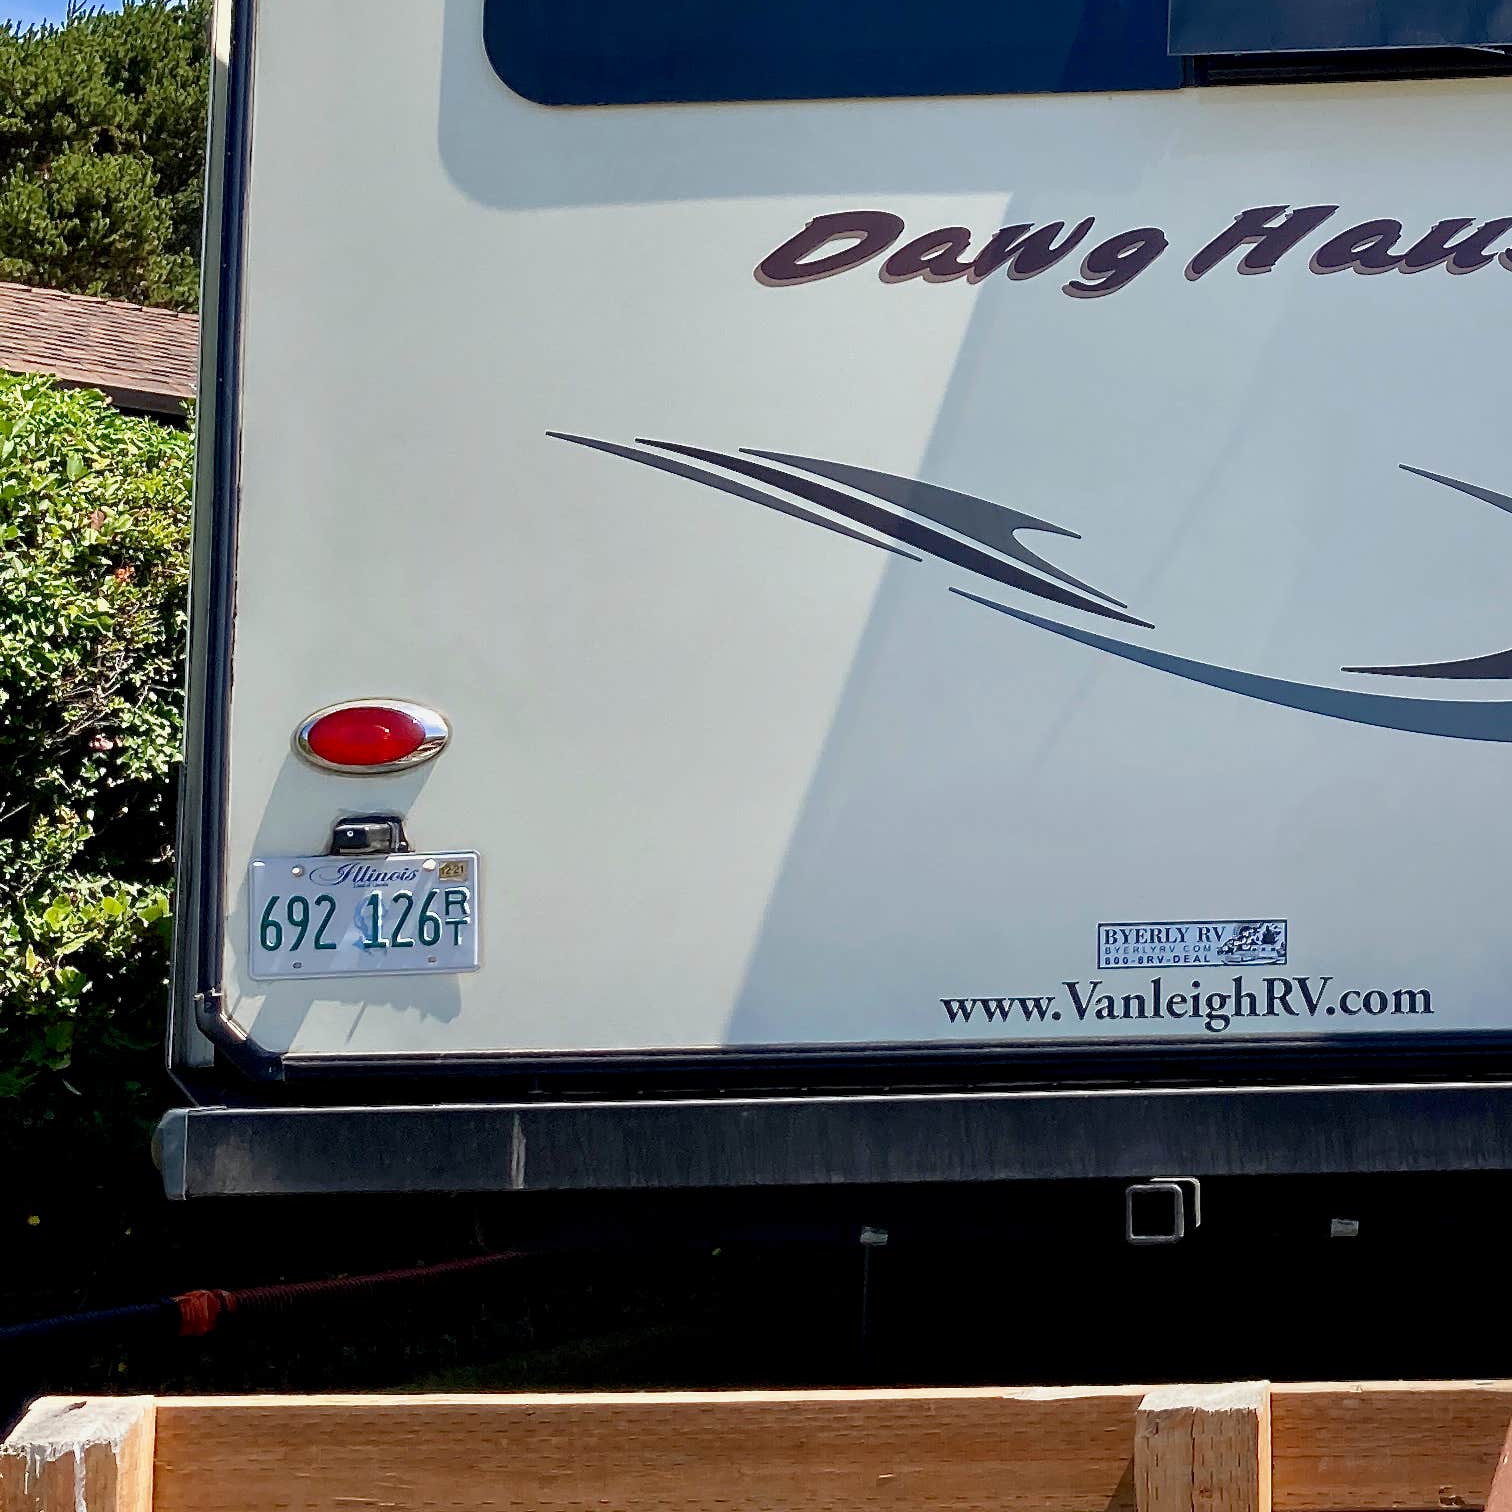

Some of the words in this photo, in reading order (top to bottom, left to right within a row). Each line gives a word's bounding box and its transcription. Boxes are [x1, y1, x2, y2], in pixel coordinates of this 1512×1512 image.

[754, 210, 1169, 299] Dawg
[309, 863, 418, 885] Illinois
[444, 887, 470, 915] R
[260, 894, 337, 952] 692
[363, 887, 441, 948] 126
[445, 918, 470, 945] T
[1103, 926, 1190, 945] BYERLY
[1197, 926, 1226, 942] RV
[1105, 945, 1212, 955] BYERLYRVCOM
[940, 976, 1434, 1032] www.VanleighRV.com
